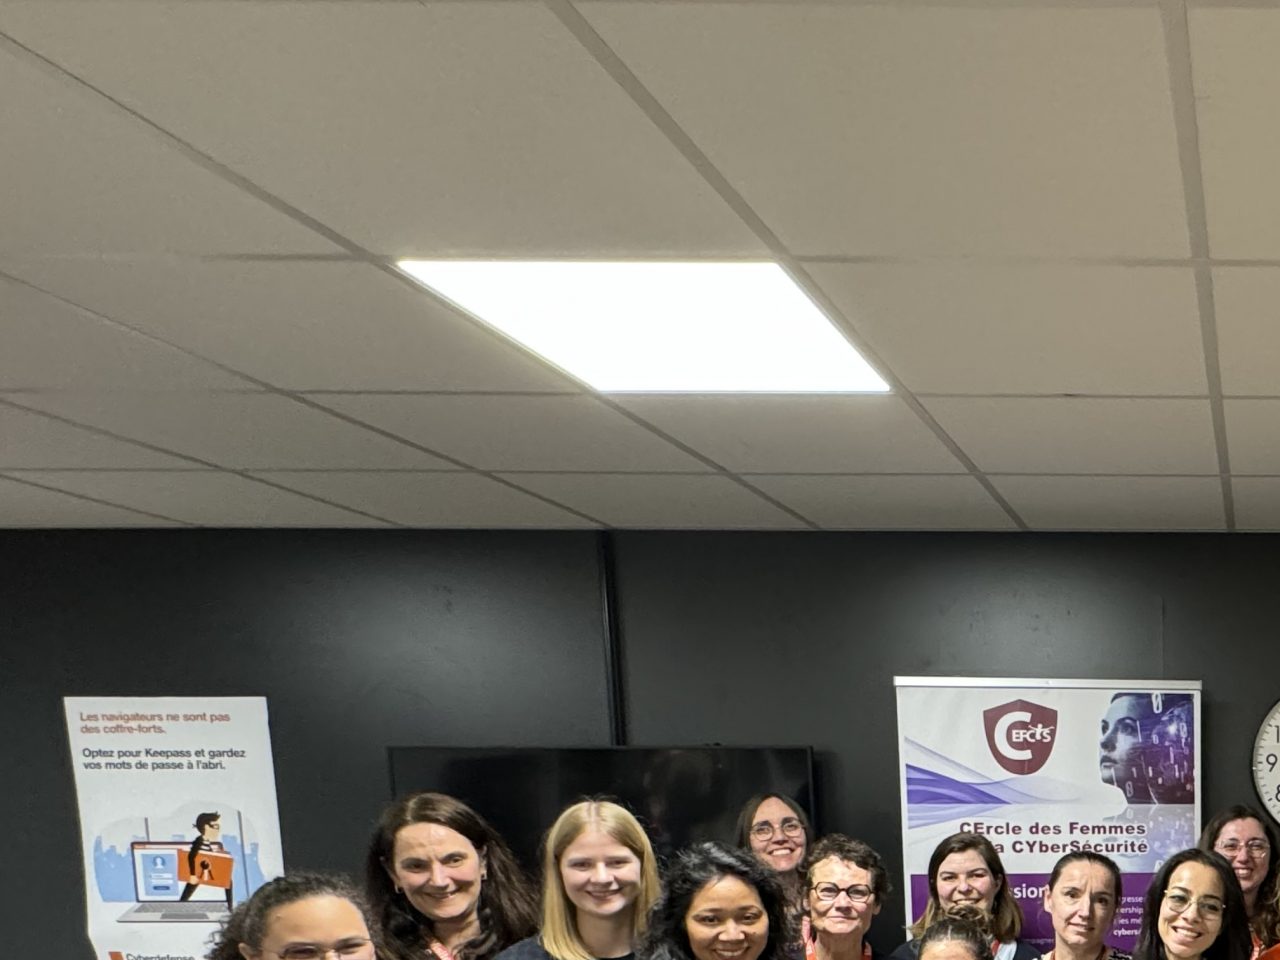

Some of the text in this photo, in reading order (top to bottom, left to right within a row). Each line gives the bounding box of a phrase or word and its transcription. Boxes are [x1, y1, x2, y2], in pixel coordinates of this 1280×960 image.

[80, 712, 231, 725] Les navigateurs ne sont pas
[80, 724, 100, 734] des
[82, 748, 246, 760] Optez pour Keepass et gardez
[83, 759, 226, 772] vos mots de passe à l'abri.
[1266, 754, 1278, 772] 9
[960, 822, 1146, 835] CErcle des Femmes
[1012, 839, 1148, 853] CYberSécurité
